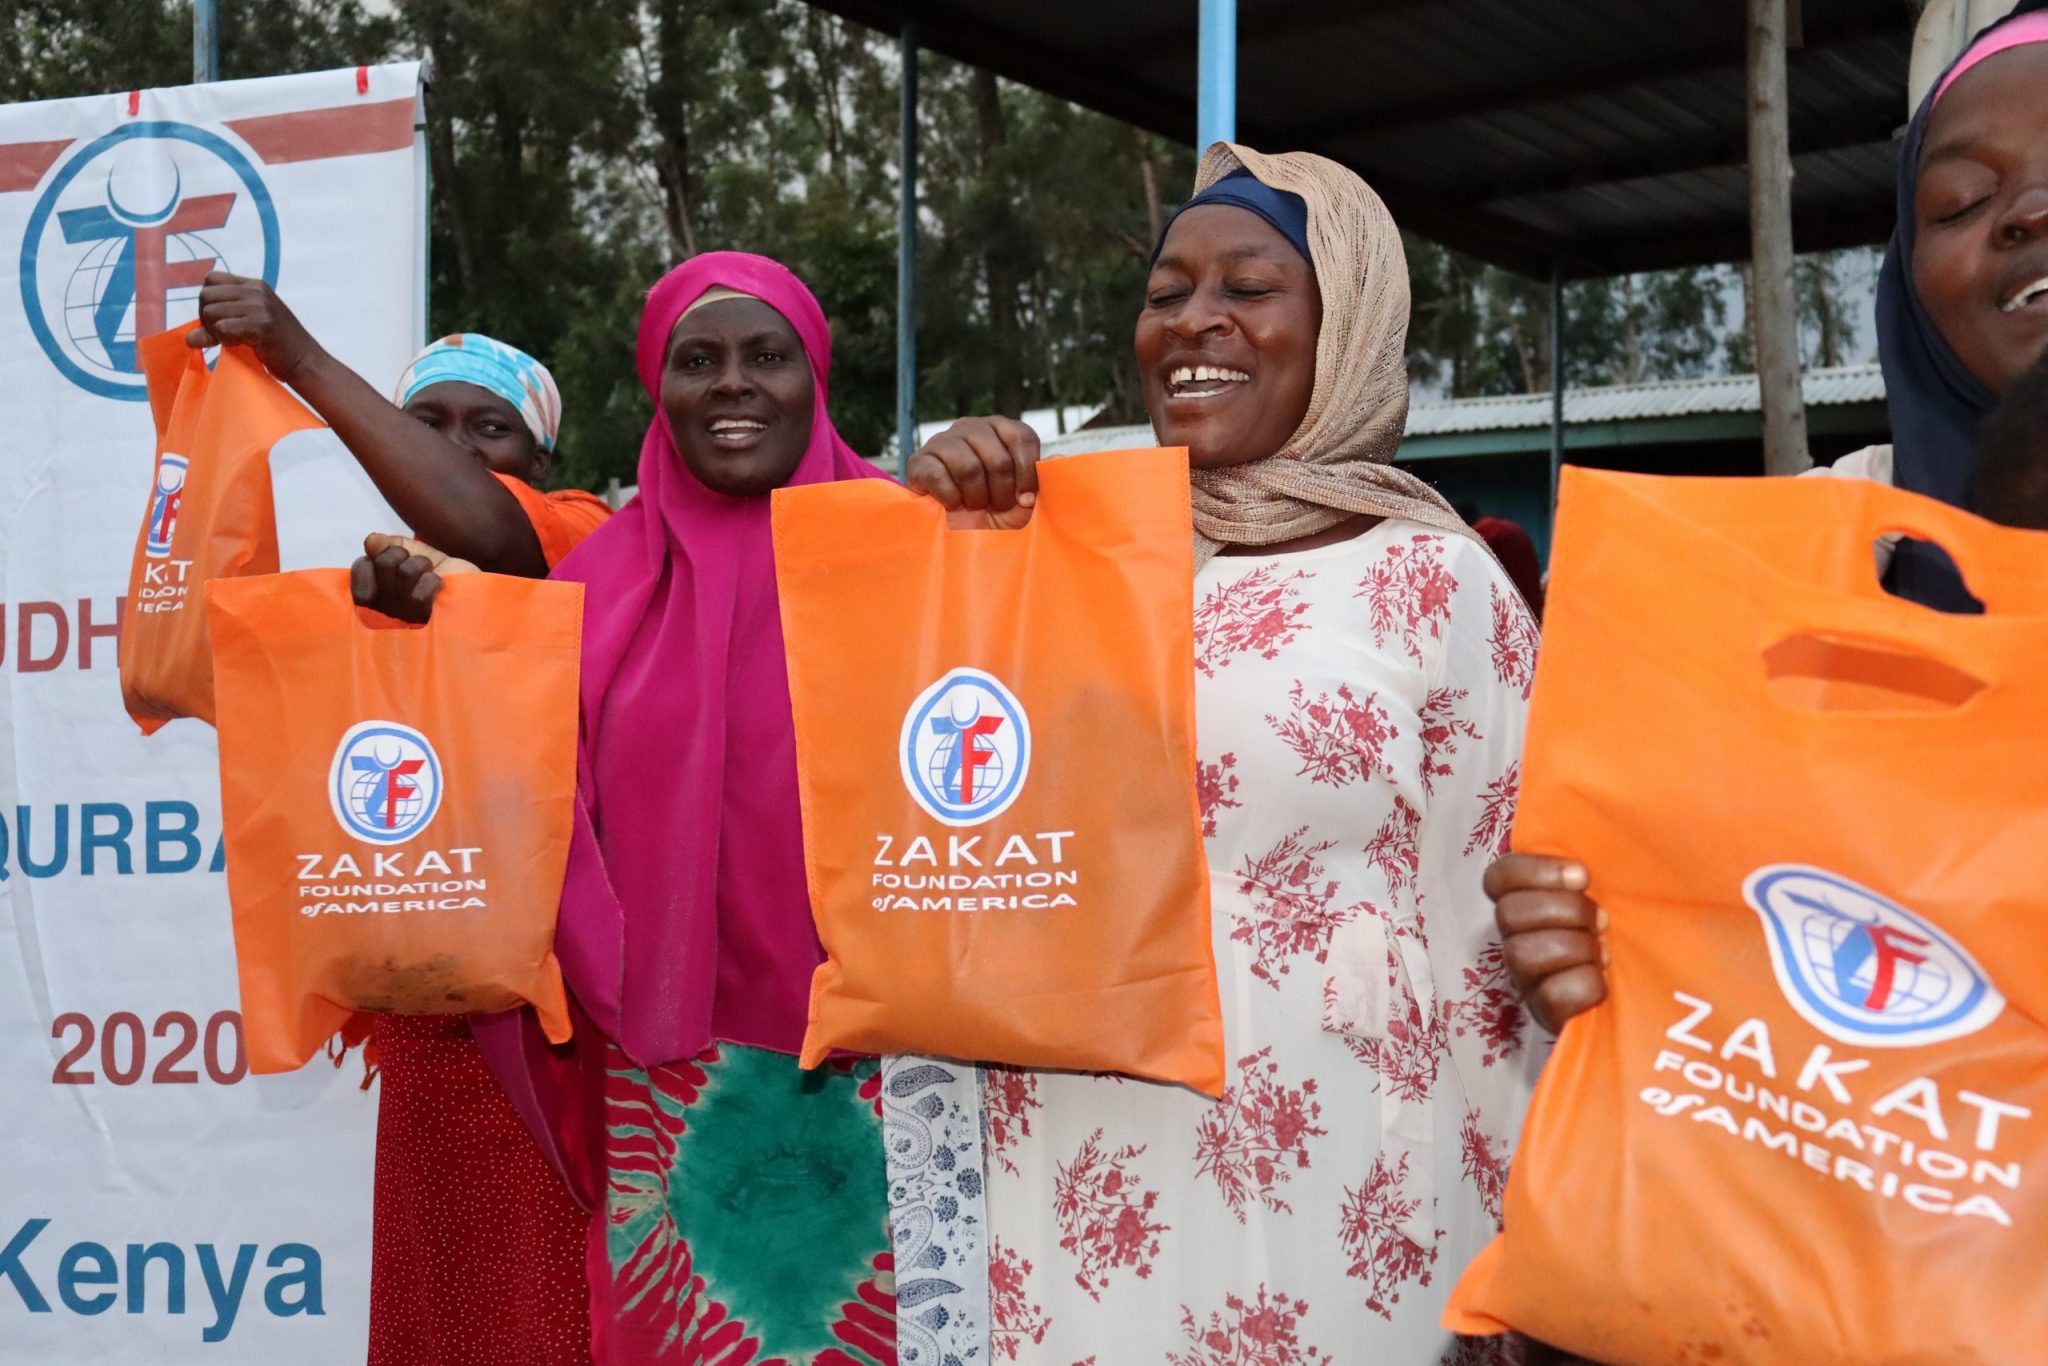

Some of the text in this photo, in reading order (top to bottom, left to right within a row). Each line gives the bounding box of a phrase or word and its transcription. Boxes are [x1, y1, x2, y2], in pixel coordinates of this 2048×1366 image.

[296, 847, 483, 880] ZAKAT
[874, 831, 1075, 868] ZAKAT
[299, 879, 486, 898] FOUNDATION
[872, 870, 1077, 890] FOUNDATION
[51, 1010, 249, 1086] 2020
[1666, 990, 2031, 1151] ZAKAT
[1654, 1050, 2021, 1188] FOUNDATION
[0, 1218, 326, 1343] Kenya
